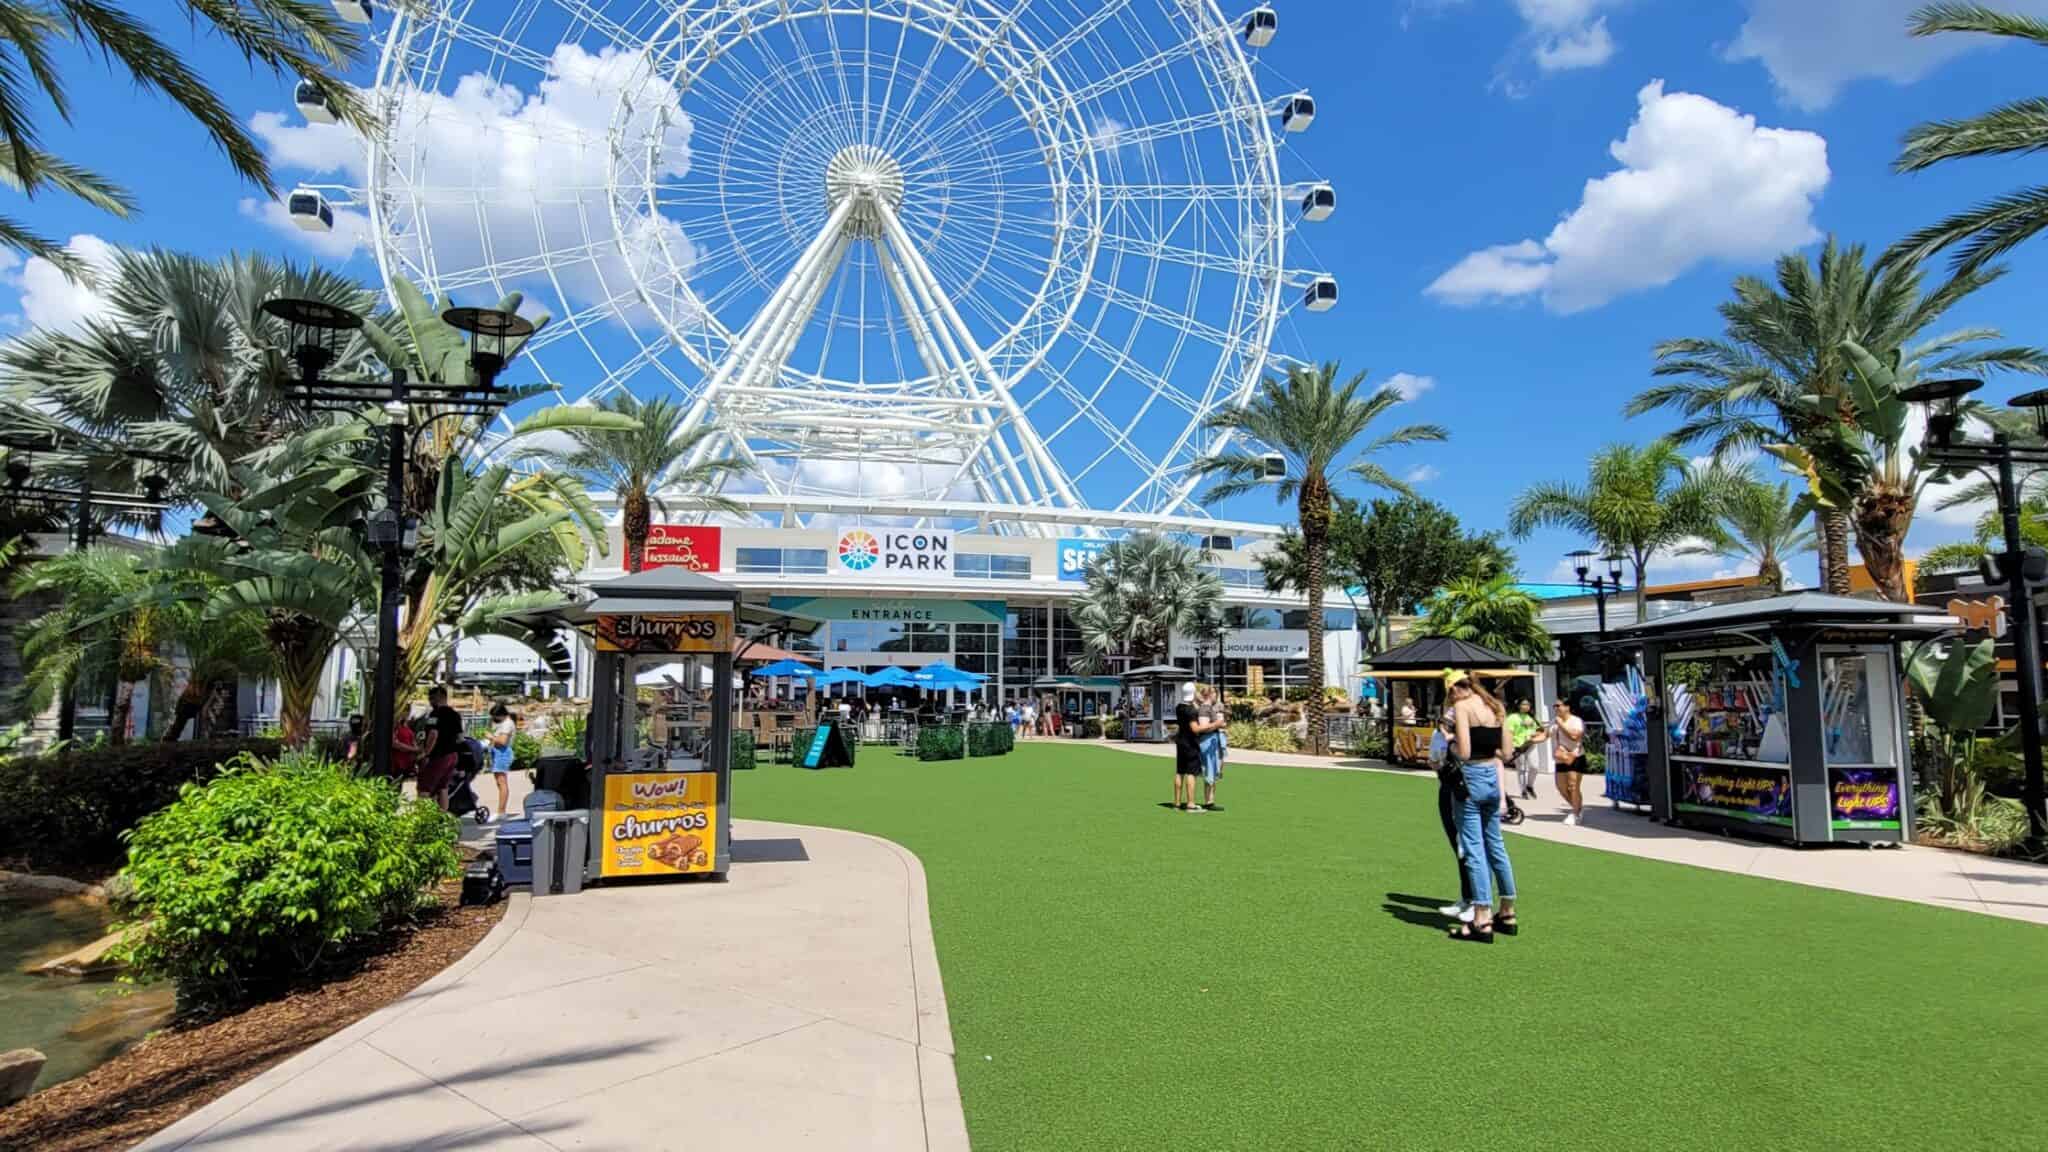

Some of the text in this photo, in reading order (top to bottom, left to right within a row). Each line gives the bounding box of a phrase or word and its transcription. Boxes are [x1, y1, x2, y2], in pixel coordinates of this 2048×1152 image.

[645, 527, 694, 546] adame
[885, 533, 948, 551] ICON
[885, 553, 948, 571] PARK
[851, 609, 933, 620] ENTRANCE
[617, 615, 715, 637] churros
[634, 778, 686, 797] Wow!
[1834, 782, 1888, 798] Everything
[1837, 795, 1864, 814] Light
[613, 812, 708, 840] churros
